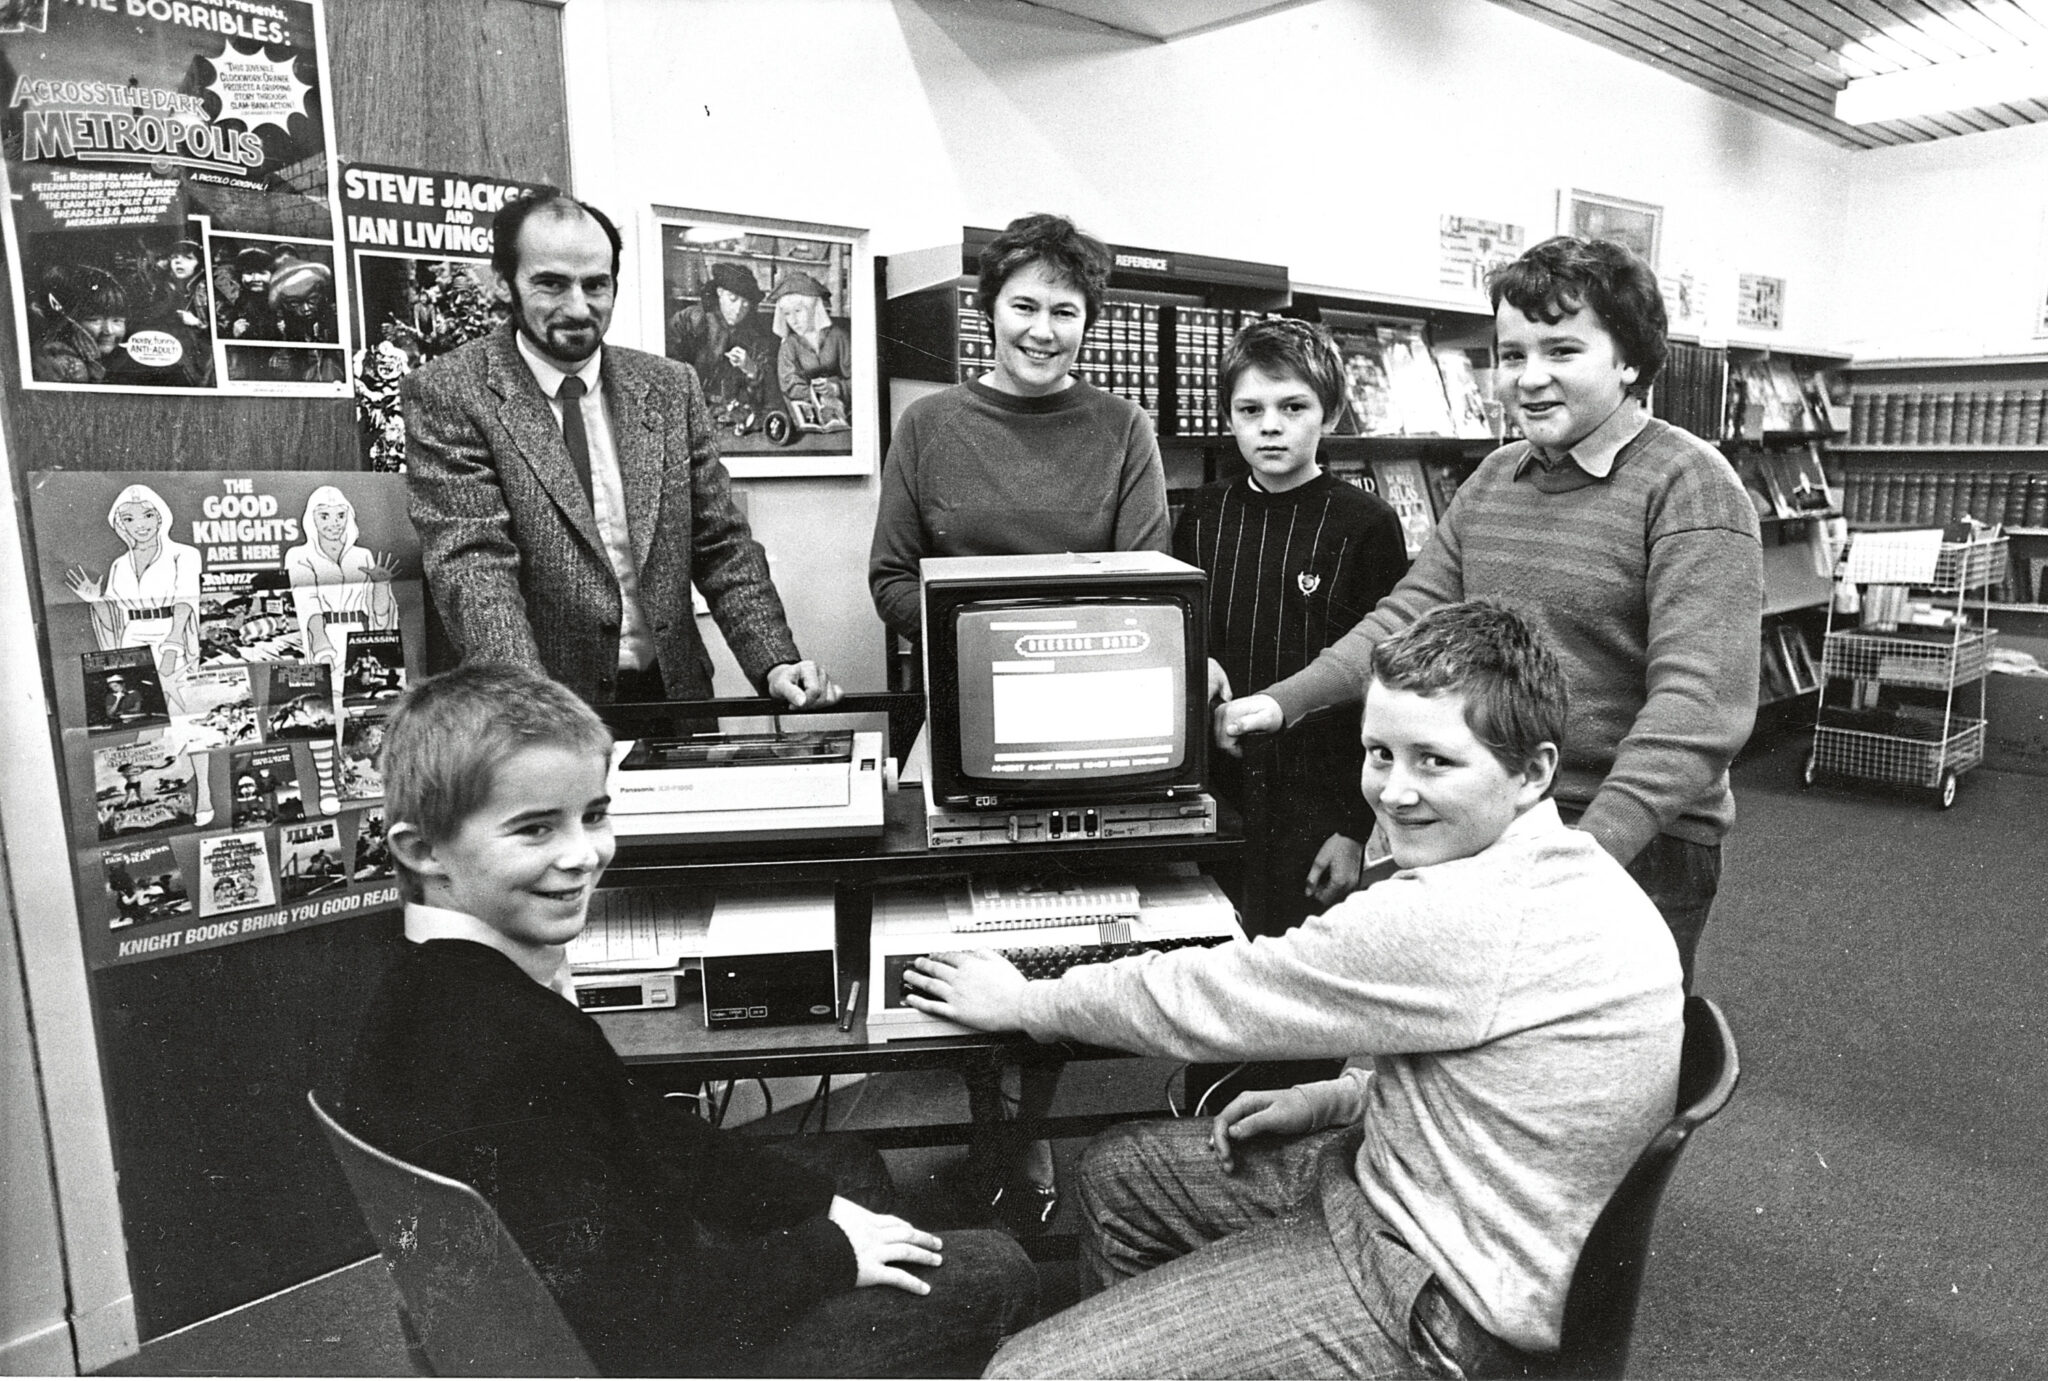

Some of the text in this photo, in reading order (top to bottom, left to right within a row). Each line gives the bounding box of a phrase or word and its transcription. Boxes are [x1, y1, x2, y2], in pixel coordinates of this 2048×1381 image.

[9, 74, 212, 121] ACROSS THE DARK
[22, 111, 265, 168] METROPOLIS
[31, 182, 88, 191] DETERMINED
[105, 181, 121, 189] FOR
[345, 168, 435, 206] STEVE
[45, 201, 61, 210] THE
[63, 200, 86, 209] DARK
[88, 198, 141, 207] METROPOLIS
[53, 209, 94, 218] DREADED
[65, 217, 119, 227] MERCENARY
[445, 209, 474, 224] AND
[347, 215, 398, 246] IAN
[1115, 254, 1167, 271] REFERENCE
[223, 479, 253, 494] THE
[203, 494, 278, 519] GOOD
[192, 518, 299, 543] KNIGHTS
[207, 544, 280, 561] ARE HERE
[349, 636, 399, 645] ASSASSIN!
[118, 931, 182, 957] KNIGHT
[185, 920, 239, 945] BOOKS
[241, 910, 287, 933] BRING
[290, 903, 319, 923] YOU
[321, 894, 360, 917] GOOD
